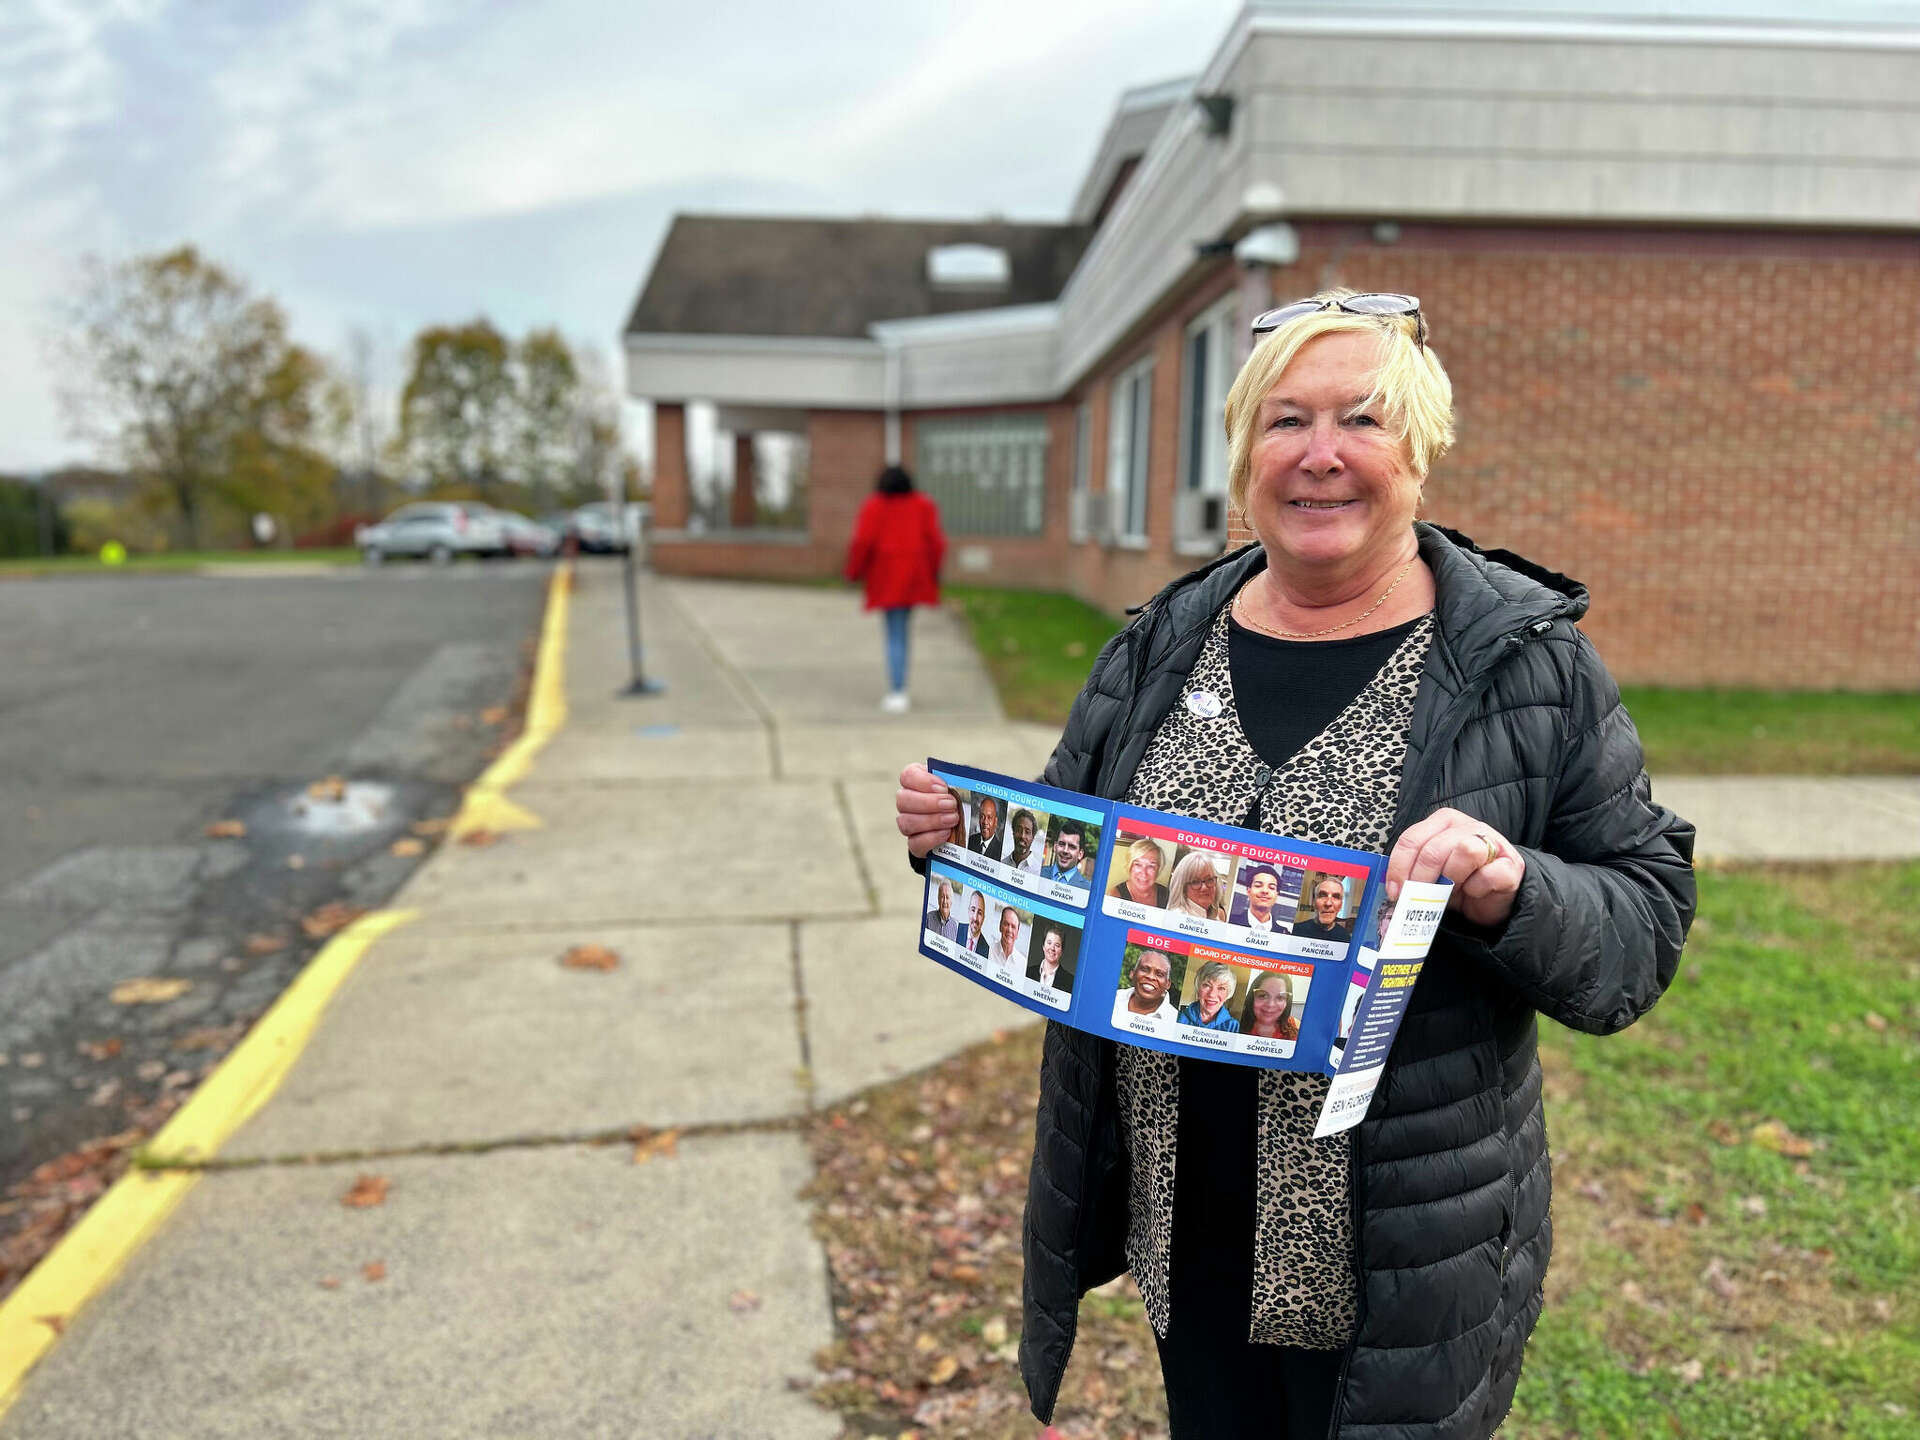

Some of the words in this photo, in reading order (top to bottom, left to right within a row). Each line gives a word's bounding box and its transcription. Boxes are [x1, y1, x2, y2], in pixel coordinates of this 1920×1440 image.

[1197, 704, 1214, 716] Voted
[975, 783, 1009, 800] COMMON
[1010, 792, 1045, 809] COUNCIL
[1177, 832, 1217, 848] BOARD
[1222, 841, 1238, 852] OF
[1241, 846, 1309, 867] EDUCATION
[1010, 877, 1024, 886] FORD
[967, 877, 997, 896] COMMON
[998, 889, 1031, 908] COUNCIL
[1117, 908, 1146, 920] CROOKS
[1405, 909, 1422, 921] VOTE
[1423, 909, 1438, 921] ROW
[1179, 923, 1209, 935] DANIELS
[1146, 935, 1172, 949] BOE
[1245, 937, 1269, 947] GRANT
[1301, 946, 1334, 957] PANCIERA
[1194, 947, 1220, 959] BOARD
[1221, 952, 1231, 961] OF
[1231, 955, 1279, 970] ASSESSMENT
[1280, 963, 1310, 974] APPEALS
[1033, 989, 1058, 1004] SWEENEY
[1129, 1022, 1155, 1034] OWENS
[1193, 1029, 1220, 1039] Rebecca
[1181, 1034, 1228, 1048] McCLANAHAN
[1246, 1044, 1284, 1055] SCHOFIELD
[1331, 1099, 1346, 1114] BEN
